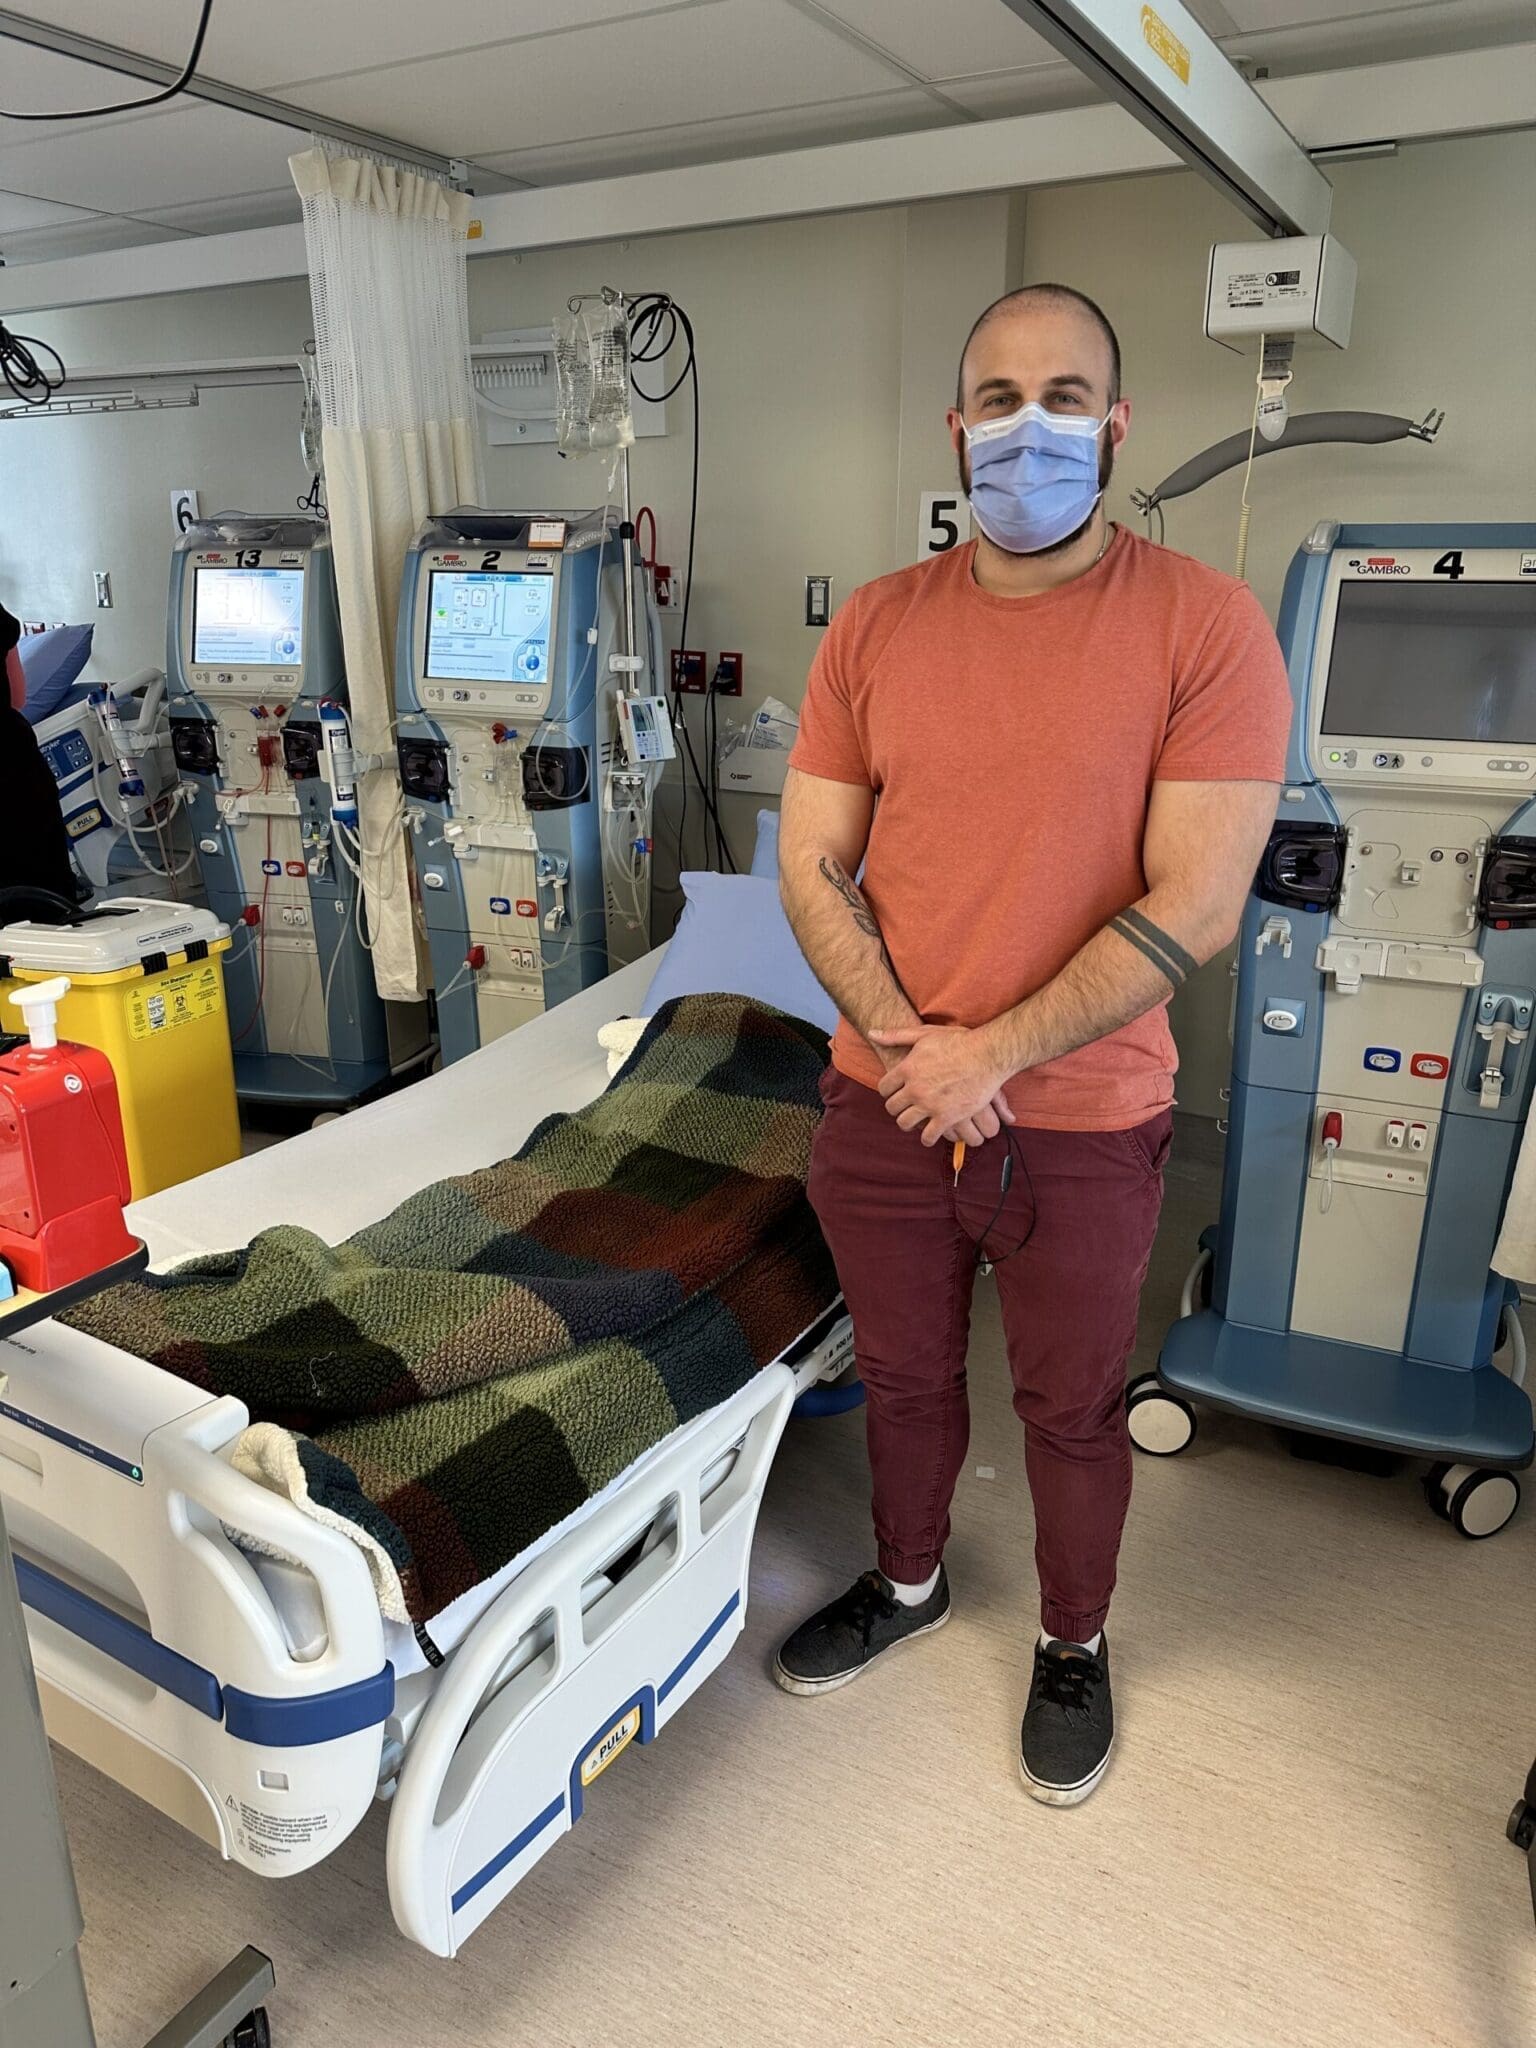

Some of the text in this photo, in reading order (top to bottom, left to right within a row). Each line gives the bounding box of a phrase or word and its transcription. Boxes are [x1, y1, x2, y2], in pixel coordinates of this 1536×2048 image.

[177, 497, 194, 533] 6
[929, 500, 958, 552] 5
[235, 550, 262, 568] 13
[481, 551, 501, 570] 2
[1357, 565, 1410, 574] GAMBRO
[1433, 551, 1464, 579] 4
[77, 815, 94, 827] PULL
[600, 1725, 628, 1758] PULL
